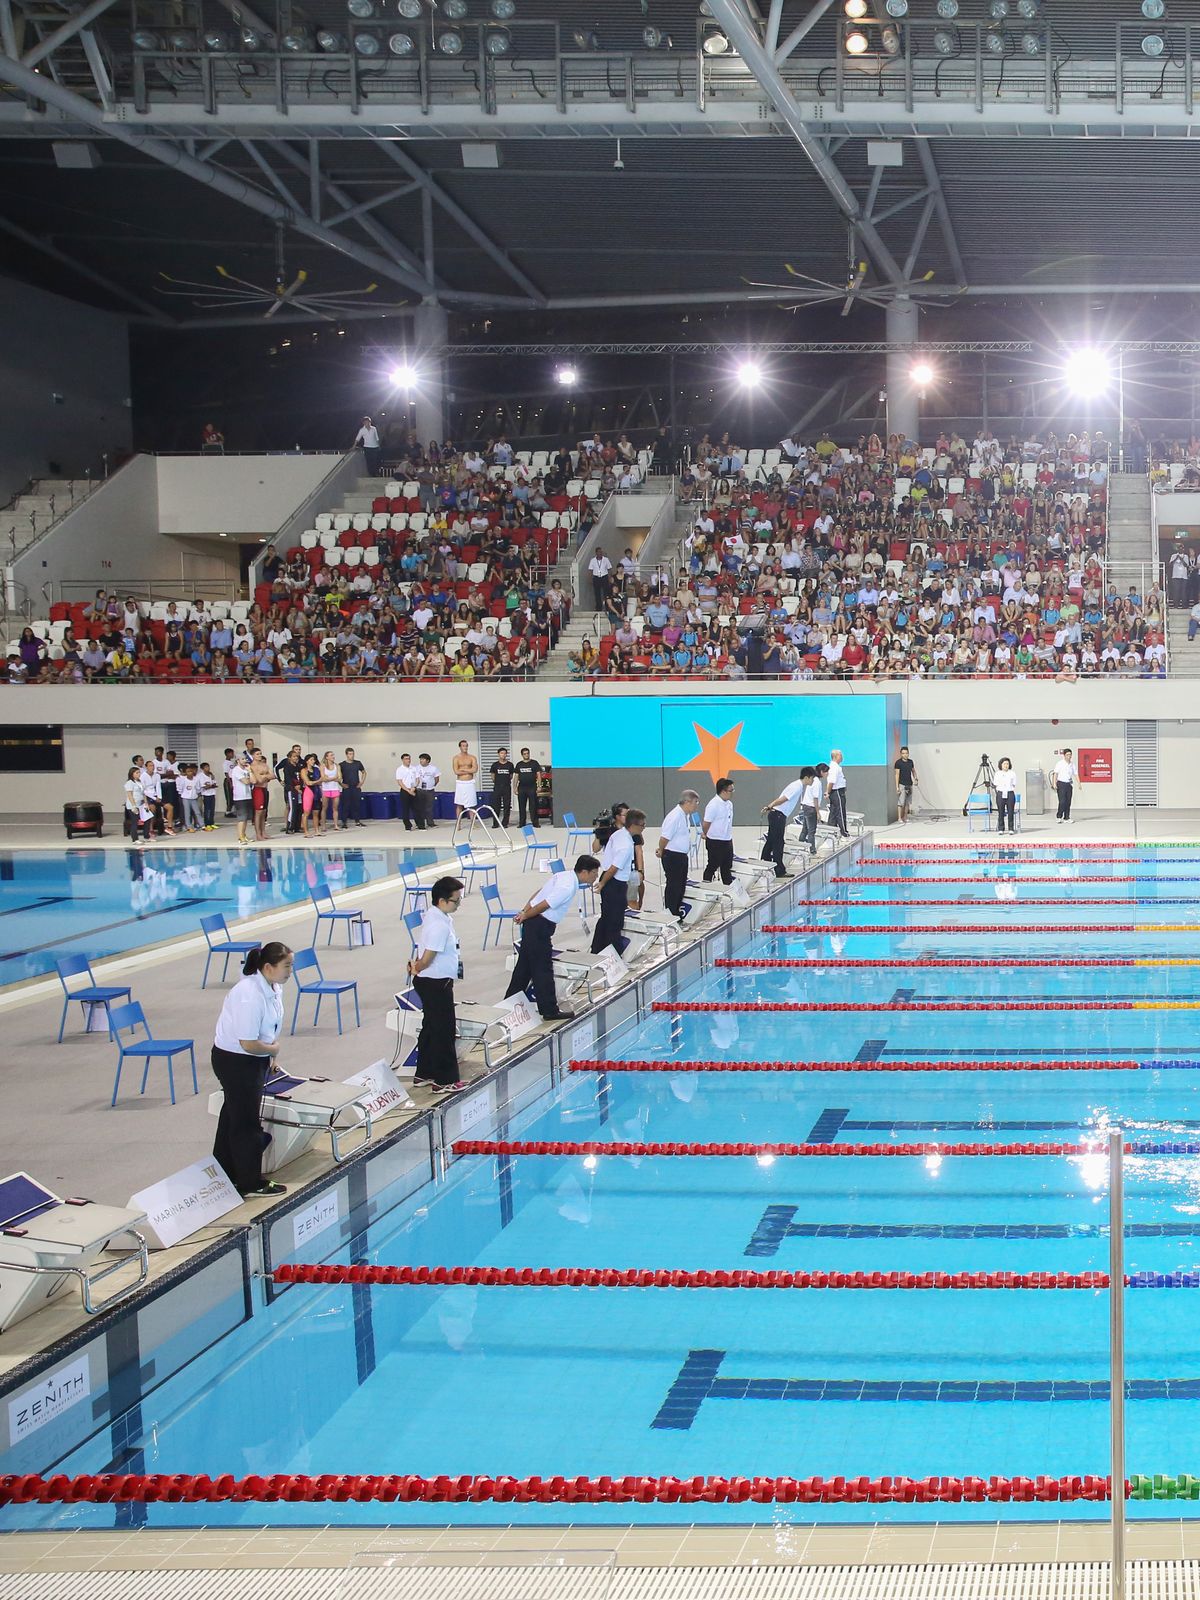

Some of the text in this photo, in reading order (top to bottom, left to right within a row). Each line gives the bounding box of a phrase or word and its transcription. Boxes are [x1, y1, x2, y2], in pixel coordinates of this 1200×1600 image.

[153, 1203, 184, 1225] MARINA
[183, 1193, 200, 1208] BAY
[297, 1202, 335, 1236] ZENITH
[16, 1372, 84, 1426] ZENITH
